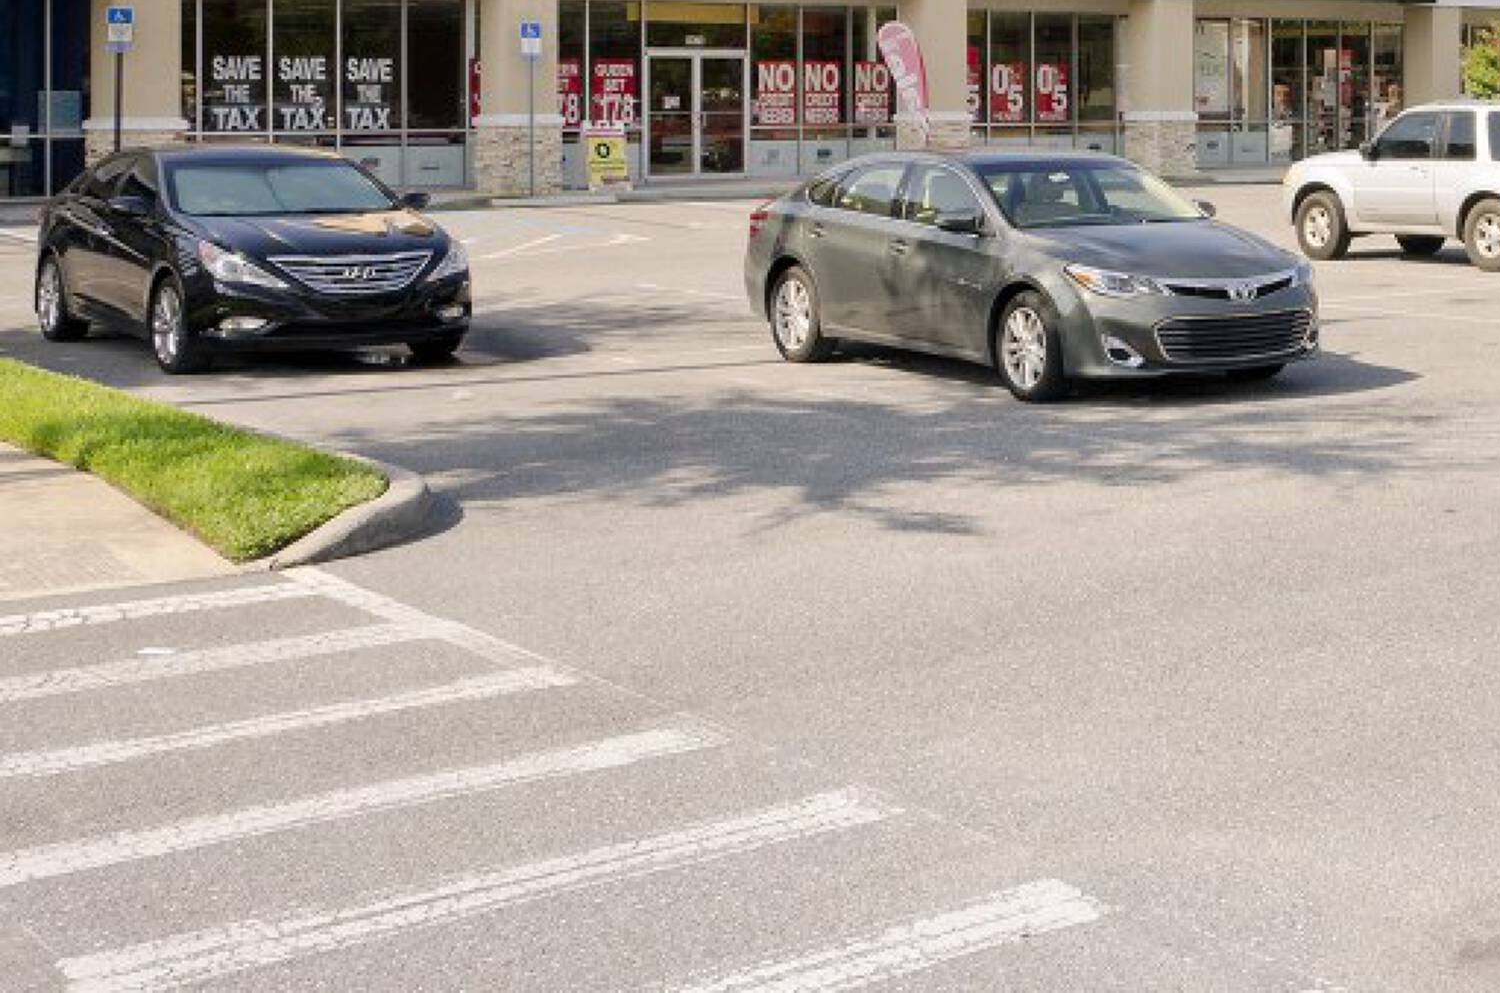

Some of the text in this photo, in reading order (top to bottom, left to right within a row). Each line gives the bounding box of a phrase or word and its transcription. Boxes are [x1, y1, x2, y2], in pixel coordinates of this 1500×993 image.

[213, 56, 261, 80] SAVE
[279, 57, 326, 80] SAVE
[347, 58, 393, 82] SAVE
[758, 63, 795, 92] NO
[805, 63, 839, 92] NO
[855, 63, 889, 92] NO
[222, 84, 251, 104] THE
[289, 84, 317, 104] THE
[357, 84, 382, 104] THE
[1008, 84, 1023, 111] 5
[1052, 84, 1067, 111] 5
[212, 108, 259, 130] TAX
[280, 108, 325, 130] TAX
[346, 108, 391, 130] TAX
